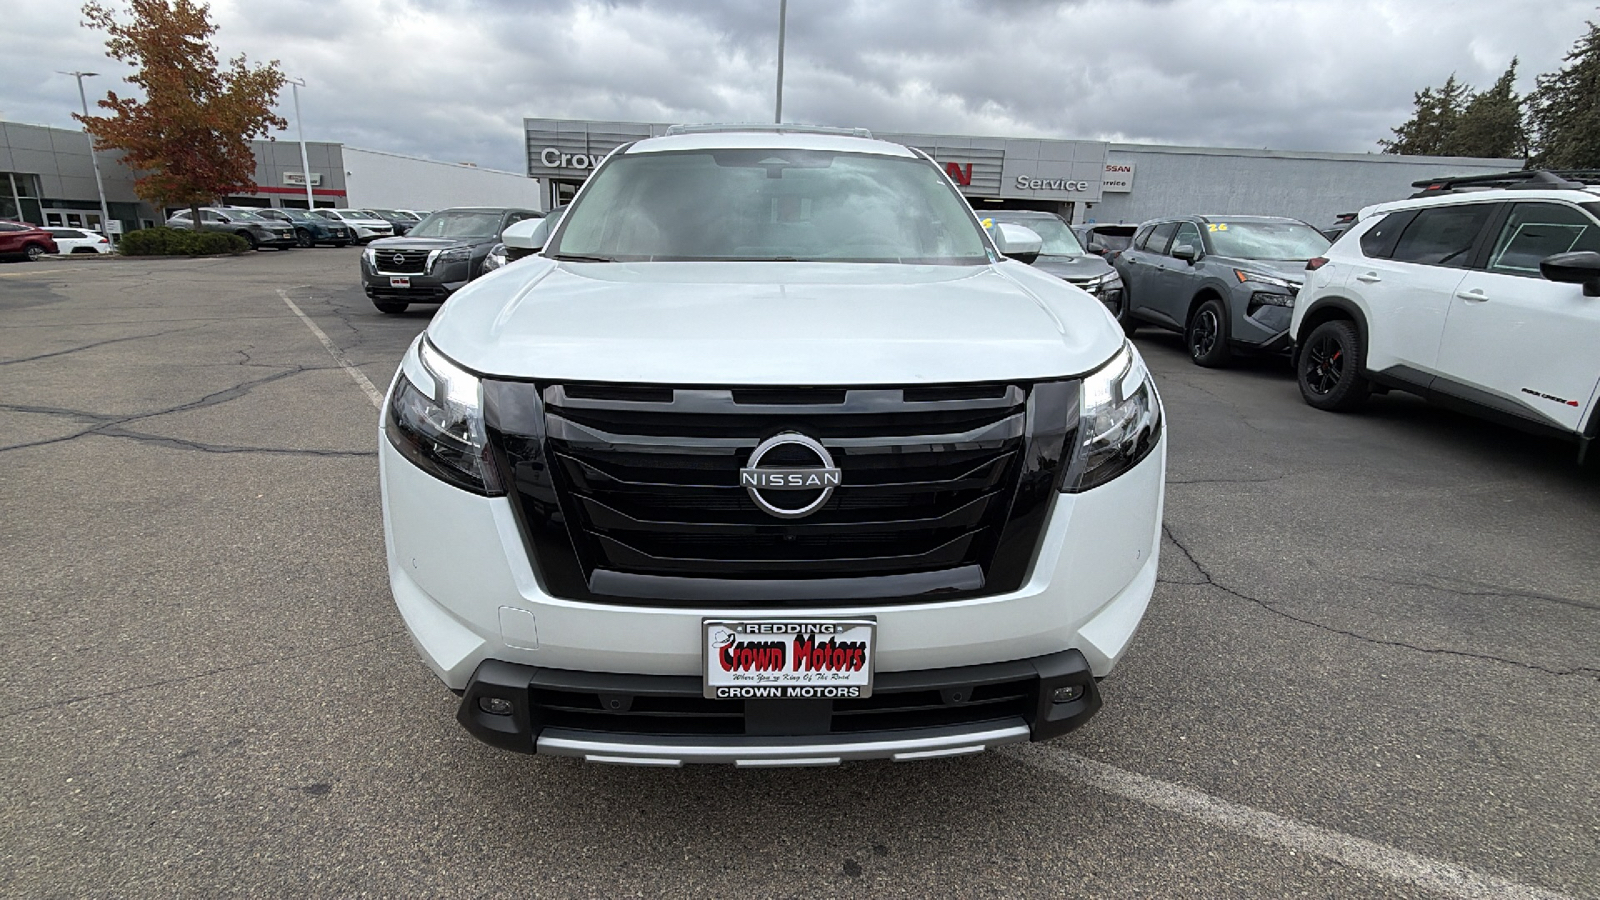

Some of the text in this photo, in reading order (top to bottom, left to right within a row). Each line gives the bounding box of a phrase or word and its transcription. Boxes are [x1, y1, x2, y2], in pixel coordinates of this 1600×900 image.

[1016, 174, 1089, 192] Service
[742, 472, 839, 486] NISSAN
[746, 624, 835, 633] REDDING
[719, 634, 867, 672] Crown Motors
[732, 673, 755, 681] Where
[782, 673, 800, 682] King
[802, 673, 813, 682] Of
[815, 673, 828, 681] The
[831, 673, 851, 681] Road
[717, 687, 859, 697] CROWN MOTORS
